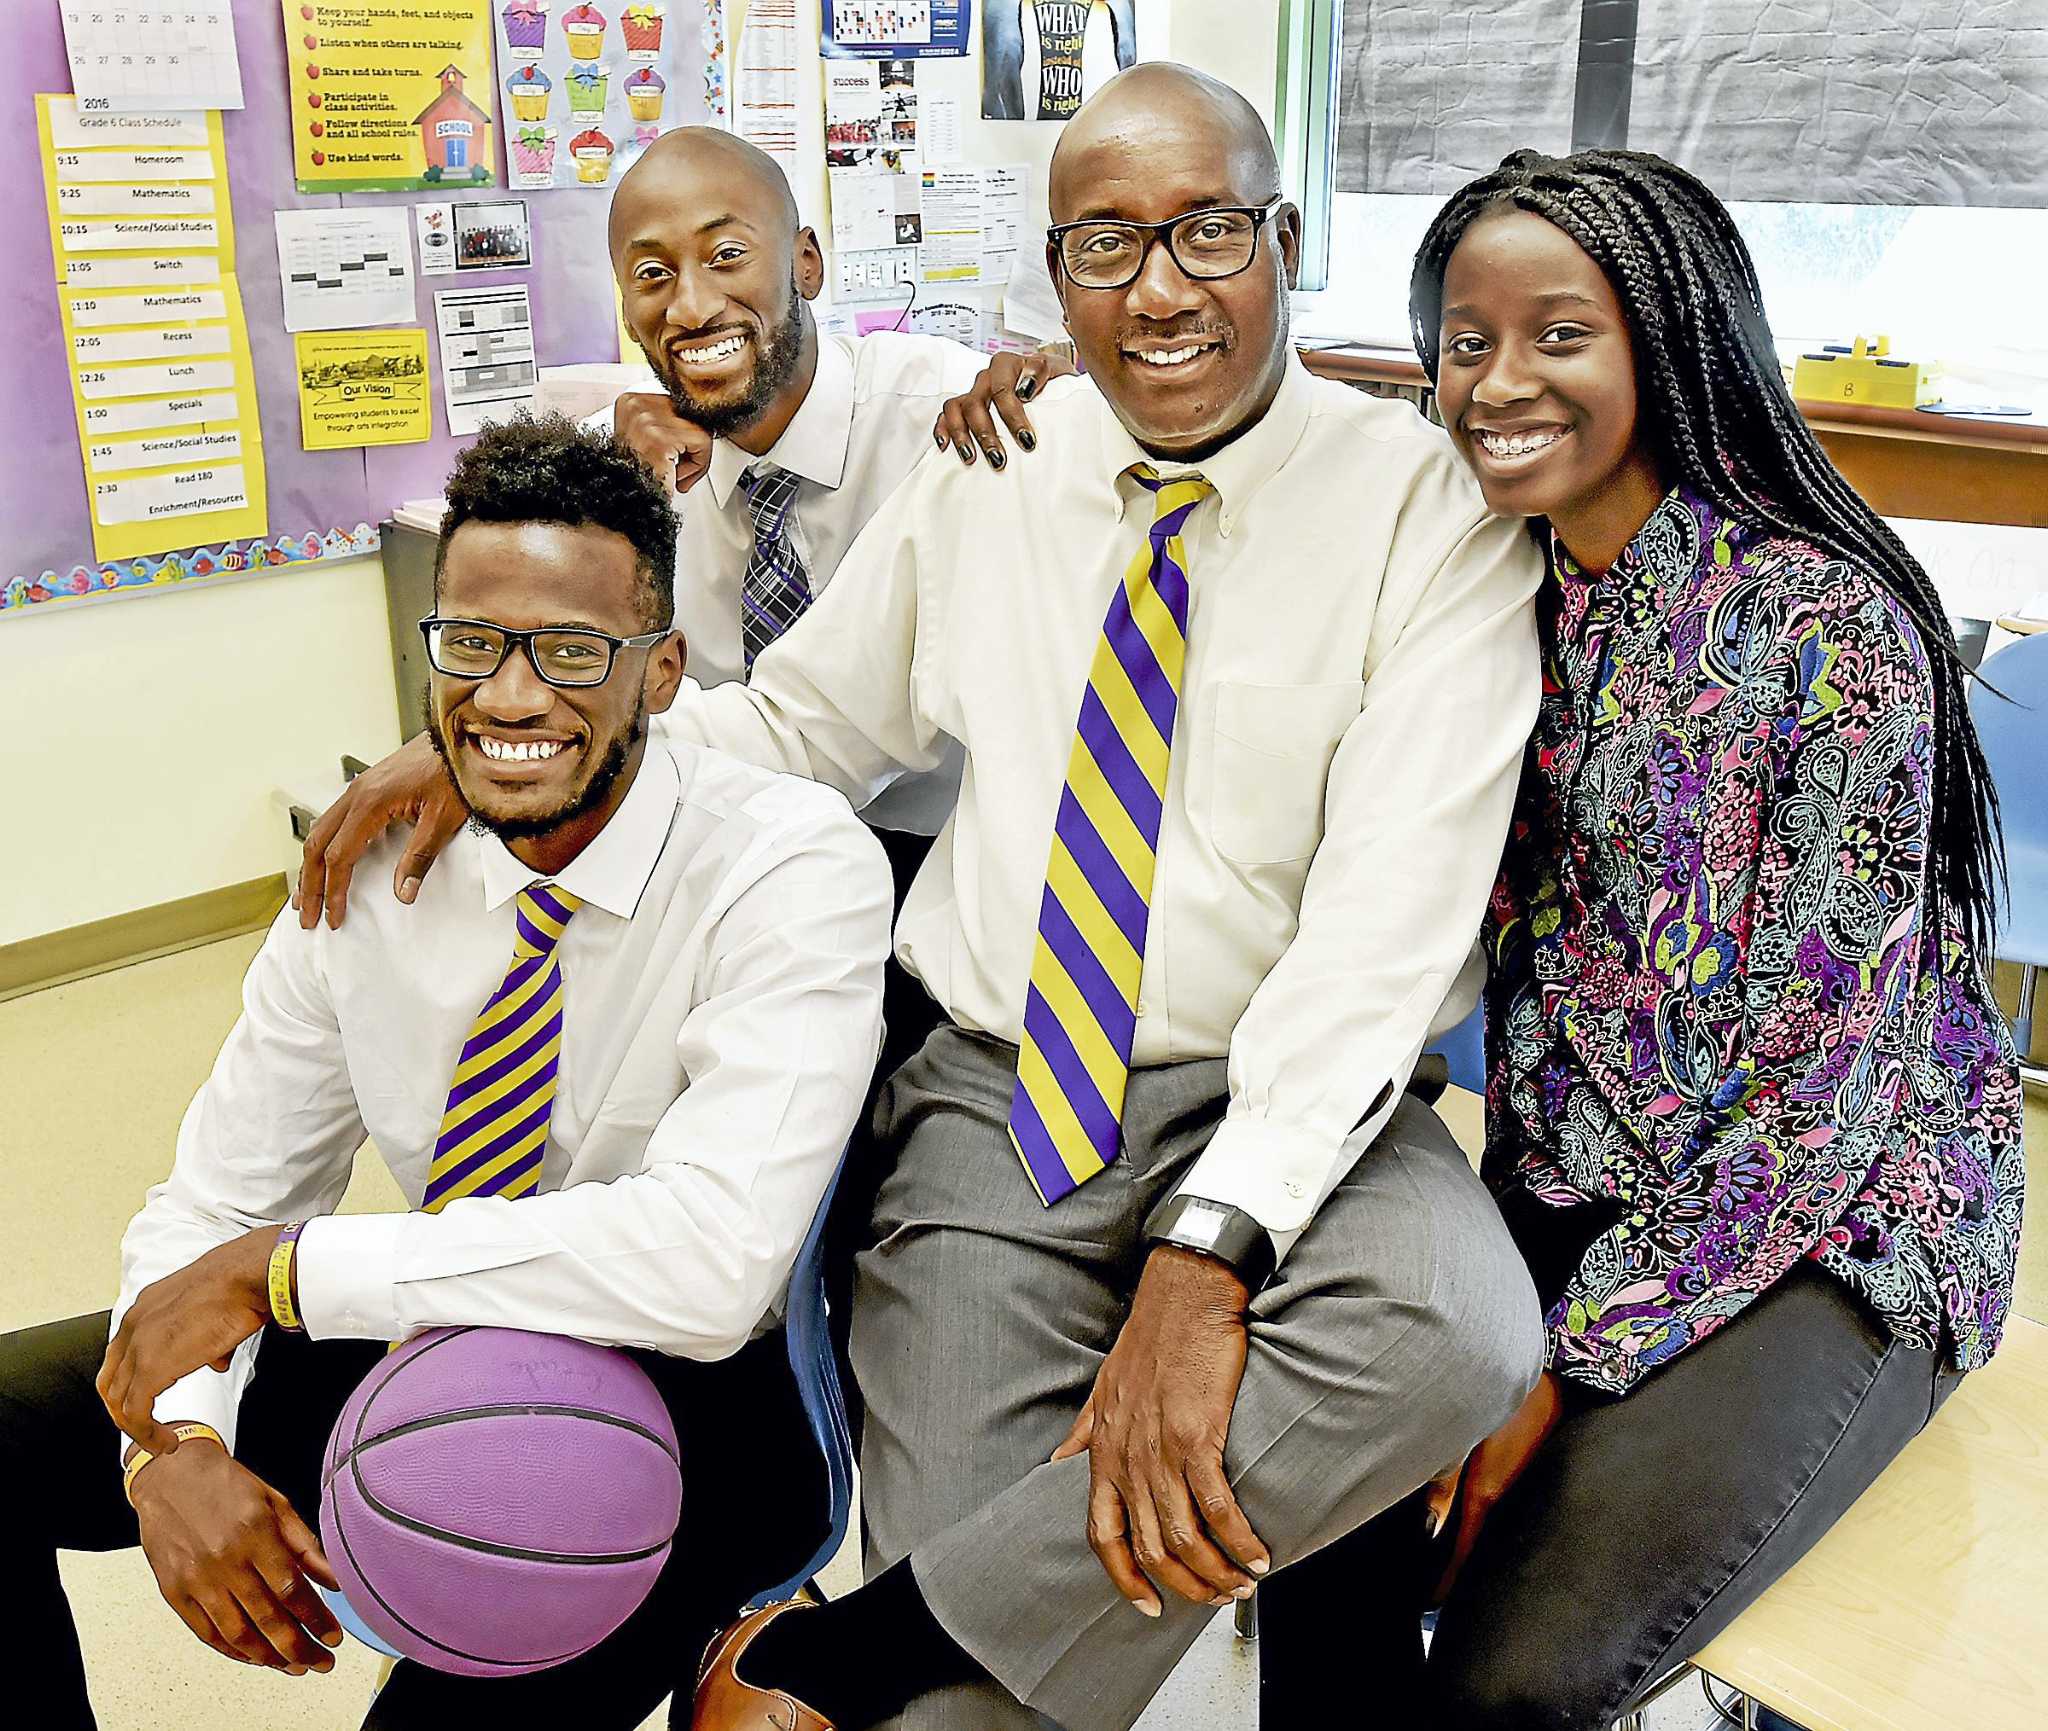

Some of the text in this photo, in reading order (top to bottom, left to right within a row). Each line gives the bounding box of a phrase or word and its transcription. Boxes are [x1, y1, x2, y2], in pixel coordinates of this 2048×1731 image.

[91, 14, 103, 23] 20
[115, 14, 125, 23] 21
[138, 14, 149, 23] 22
[162, 15, 173, 23] 23
[185, 15, 195, 23] 24
[317, 7, 341, 17] Keep
[343, 9, 365, 18] your
[368, 8, 399, 18] hands,
[424, 10, 440, 18] and
[443, 10, 473, 21] objects
[1035, 3, 1087, 34] WHAT
[318, 18, 372, 28] to yourself.
[320, 38, 464, 51] Listen when others are talking.
[1041, 32, 1083, 55] is right
[97, 56, 109, 64] 27
[122, 56, 133, 64] 28
[323, 67, 422, 76] Share and take turns.
[1042, 66, 1082, 96] WHO
[84, 98, 109, 109] 2016
[324, 93, 389, 104] Participate in
[1042, 93, 1052, 110] is
[324, 103, 398, 111] class activities.
[80, 117, 182, 128] Grade 6 Class Schedule
[326, 119, 407, 129] Follow directions
[326, 129, 420, 138] and all school rules.
[437, 122, 473, 135] SCHOOL
[58, 156, 79, 165] 9:15
[134, 155, 184, 164] Homeroom
[327, 153, 404, 163] Use kind words.
[60, 189, 81, 198] 9:25
[132, 189, 191, 198] Mathematics
[61, 225, 88, 234] 10:15
[115, 222, 213, 233] Science/Social Studies
[67, 263, 92, 272] 11:05
[153, 261, 183, 270] Switch
[72, 301, 97, 311] 11:10
[143, 295, 202, 307] Mathematics
[163, 331, 193, 341] Recess
[75, 337, 101, 347] 12:05
[169, 366, 195, 376] Lunch
[80, 373, 106, 383] 12:26
[344, 384, 391, 395] Our Vision
[1843, 382, 1854, 398] B
[168, 400, 203, 412] Specials
[87, 409, 108, 418] 1:00
[313, 407, 420, 421] Empowering students to excel
[327, 421, 408, 432] through arts integration
[142, 434, 237, 452] Science/Social Studies
[92, 447, 112, 457] 1:45
[175, 471, 213, 484] Read 180
[97, 484, 118, 494] 2:30
[149, 493, 244, 515] Enrichment/Resources
